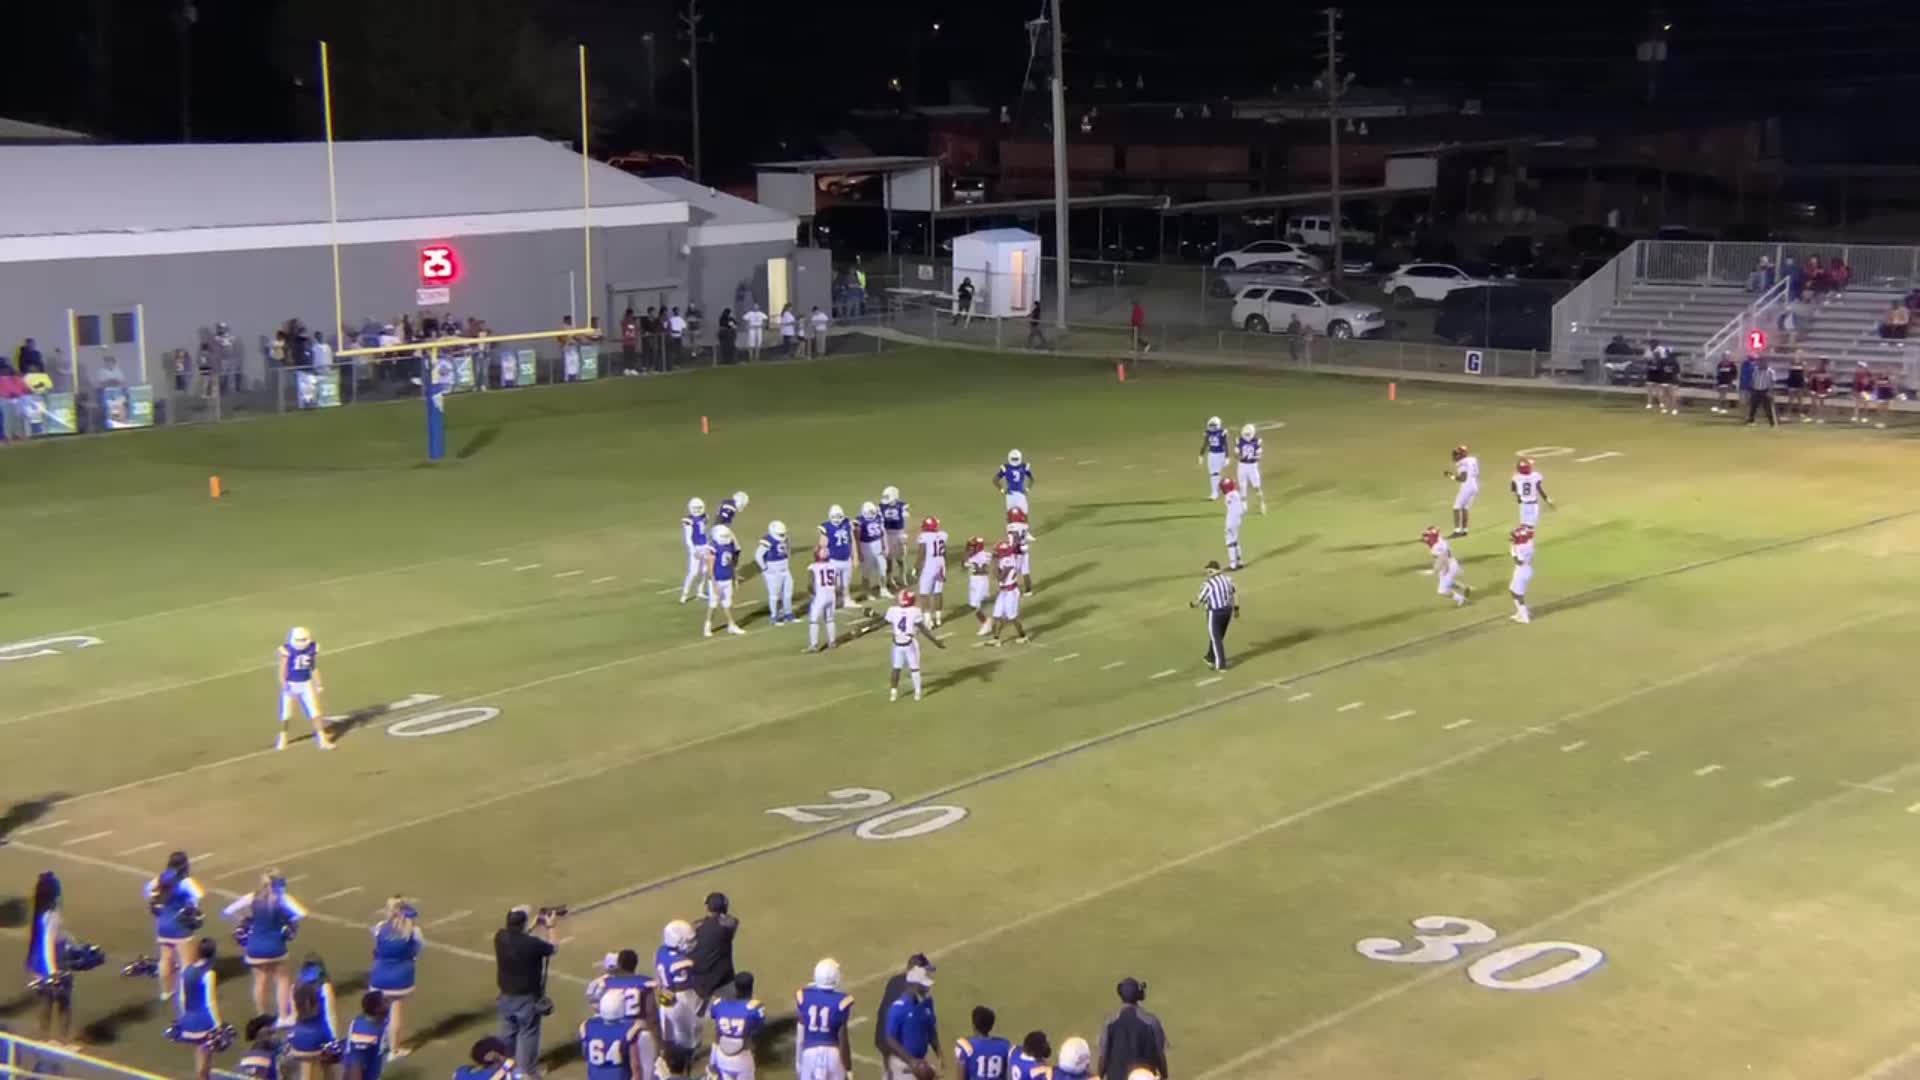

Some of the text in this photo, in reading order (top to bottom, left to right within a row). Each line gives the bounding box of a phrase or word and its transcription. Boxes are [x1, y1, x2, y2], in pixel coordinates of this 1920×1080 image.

[423, 249, 452, 277] 25
[1751, 332, 1763, 348] 2
[1468, 353, 1480, 371] G
[1522, 481, 1533, 497] 8
[933, 539, 947, 558] 12
[820, 569, 836, 587] 15
[897, 616, 908, 633] 4
[763, 787, 969, 840] 20
[1355, 914, 1604, 990] 30
[808, 1004, 831, 1033] 11
[588, 1038, 623, 1066] 64
[975, 1055, 1003, 1078] 18
